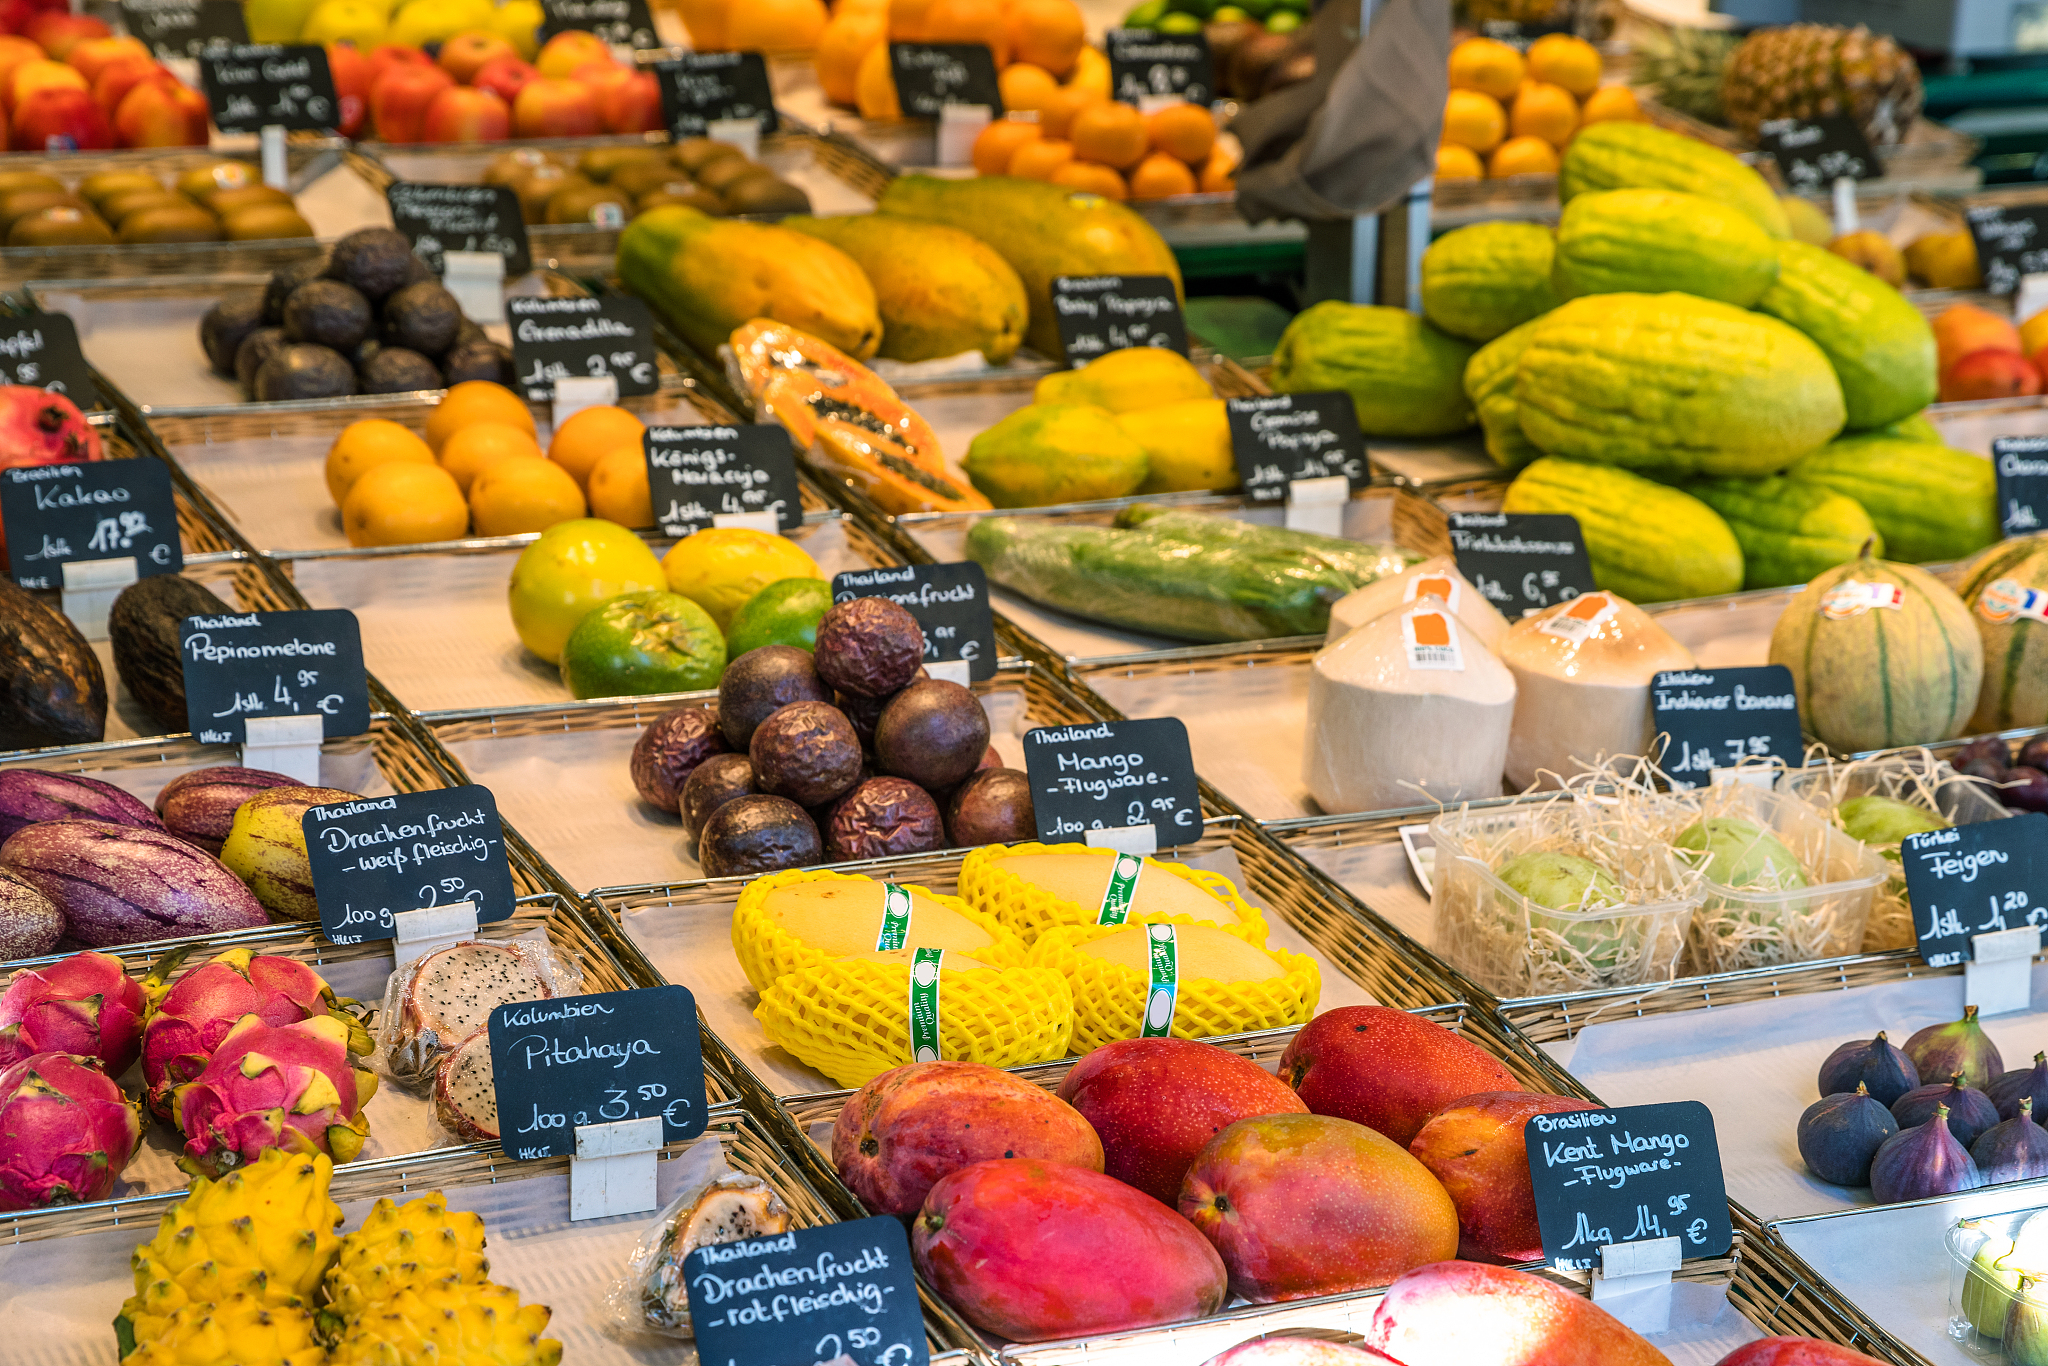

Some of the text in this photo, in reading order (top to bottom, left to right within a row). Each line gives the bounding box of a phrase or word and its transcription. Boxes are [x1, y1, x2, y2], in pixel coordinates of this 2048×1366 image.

[518, 317, 635, 342] Grenadilla
[629, 362, 652, 384] €
[672, 463, 770, 490] Maracuja
[1340, 459, 1363, 479] €
[34, 484, 131, 510] Kakao
[148, 544, 171, 566] €
[839, 565, 916, 587] Thailand
[188, 613, 261, 629] Thailand
[185, 633, 336, 664] Pepinomelone
[959, 640, 980, 661] €
[316, 694, 344, 715] €
[1654, 689, 1731, 711] Indianer
[1028, 723, 1114, 745] Thailand
[1057, 752, 1144, 776] Mango
[309, 797, 397, 822] Thailand
[1046, 816, 1084, 836] 100
[1174, 808, 1193, 827] €
[319, 808, 485, 853] Drachenfrucht
[1906, 827, 1960, 850] Türkei
[1920, 850, 2008, 882] Feigen
[332, 903, 376, 930] 100
[503, 1003, 615, 1027] Kolumbien
[920, 992, 935, 1025] Quality
[914, 1002, 931, 1041] Premium
[507, 1034, 661, 1069] Pitahaya
[517, 1103, 566, 1133] 100
[663, 1099, 690, 1127] €
[1533, 1113, 1616, 1133] Brasilien
[1543, 1131, 1690, 1167] Kent Mango
[1686, 1218, 1708, 1245] €
[694, 1231, 797, 1265] Thailand
[692, 1246, 889, 1304] Drachenfrucht
